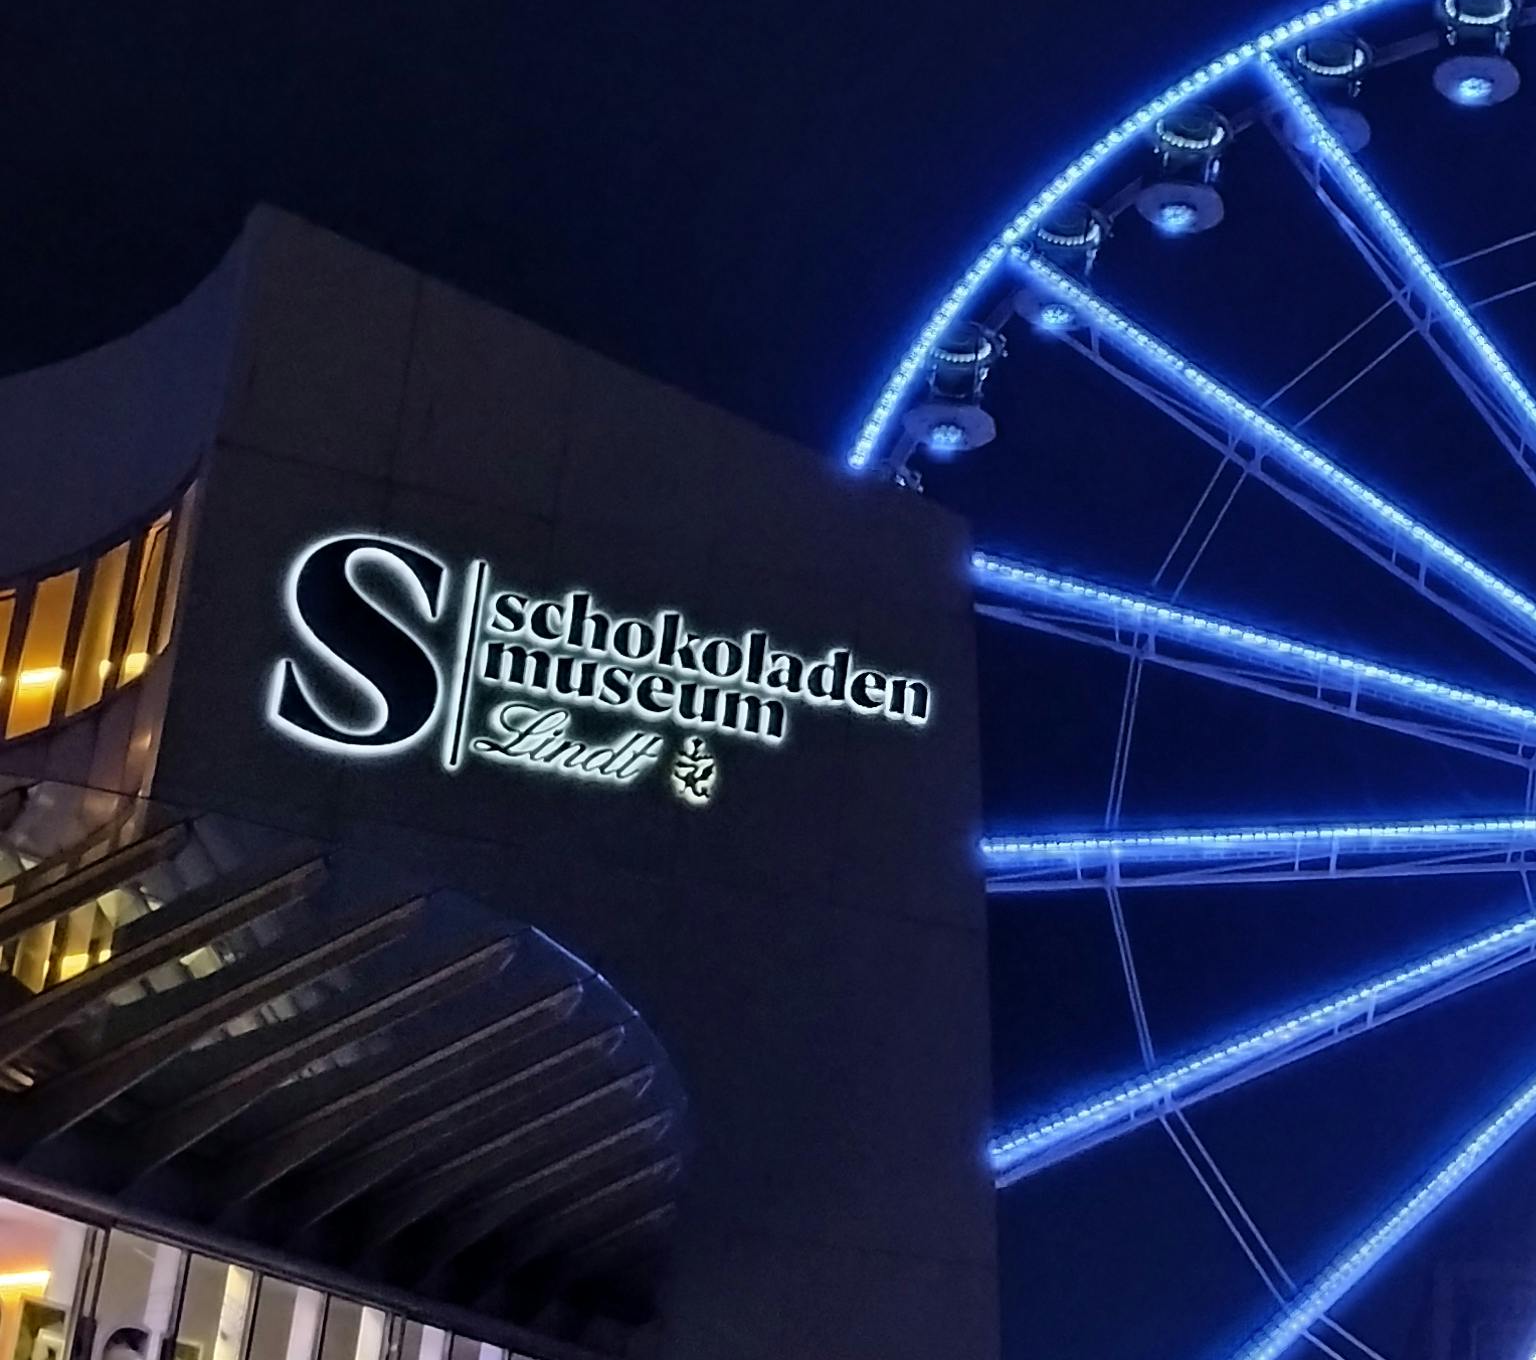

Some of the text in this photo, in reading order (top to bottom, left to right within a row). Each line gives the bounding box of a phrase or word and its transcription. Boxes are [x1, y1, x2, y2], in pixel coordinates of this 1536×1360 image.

[274, 534, 446, 748] S
[483, 639, 785, 740] museum
[491, 592, 931, 722] schokoladen
[473, 703, 662, 781] Lindt
